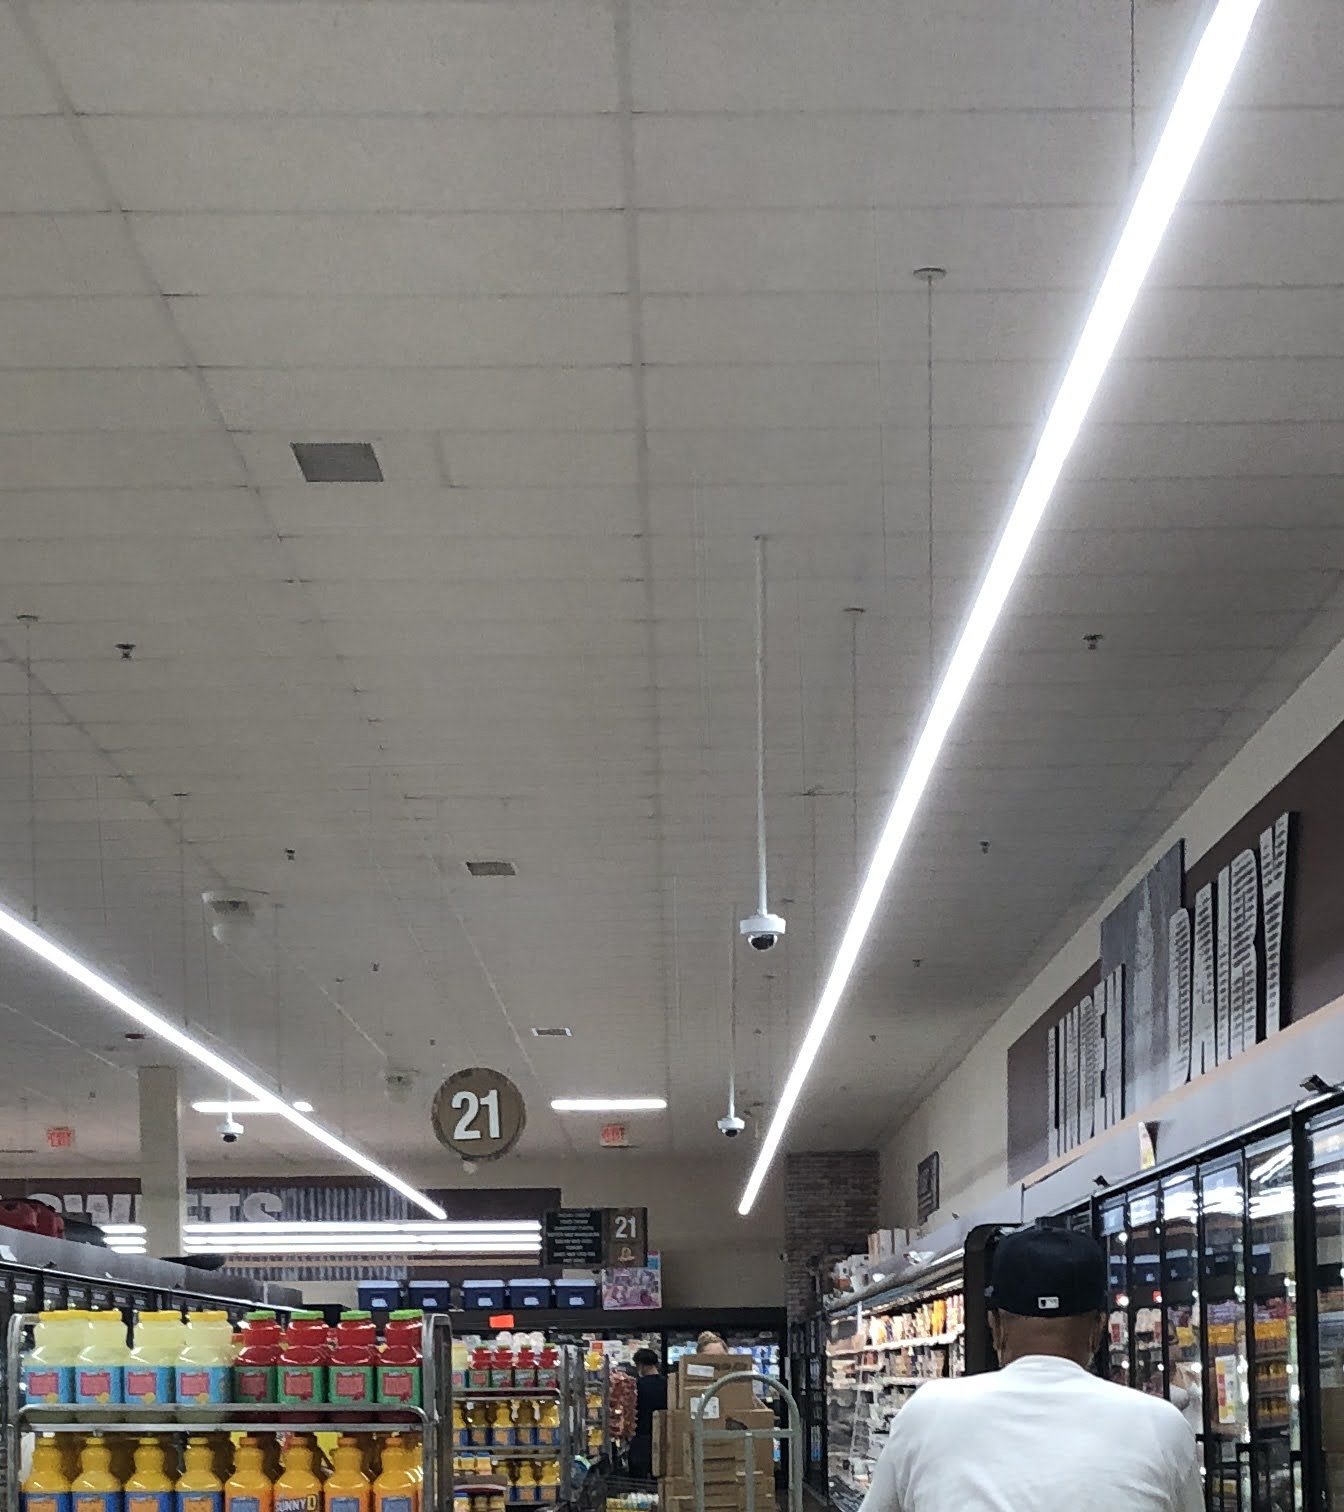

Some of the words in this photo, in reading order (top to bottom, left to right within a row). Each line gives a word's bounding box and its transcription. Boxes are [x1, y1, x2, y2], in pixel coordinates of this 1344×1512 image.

[1169, 811, 1290, 1092] DAIRY
[451, 1089, 500, 1140] 21
[615, 1216, 637, 1239] 21
